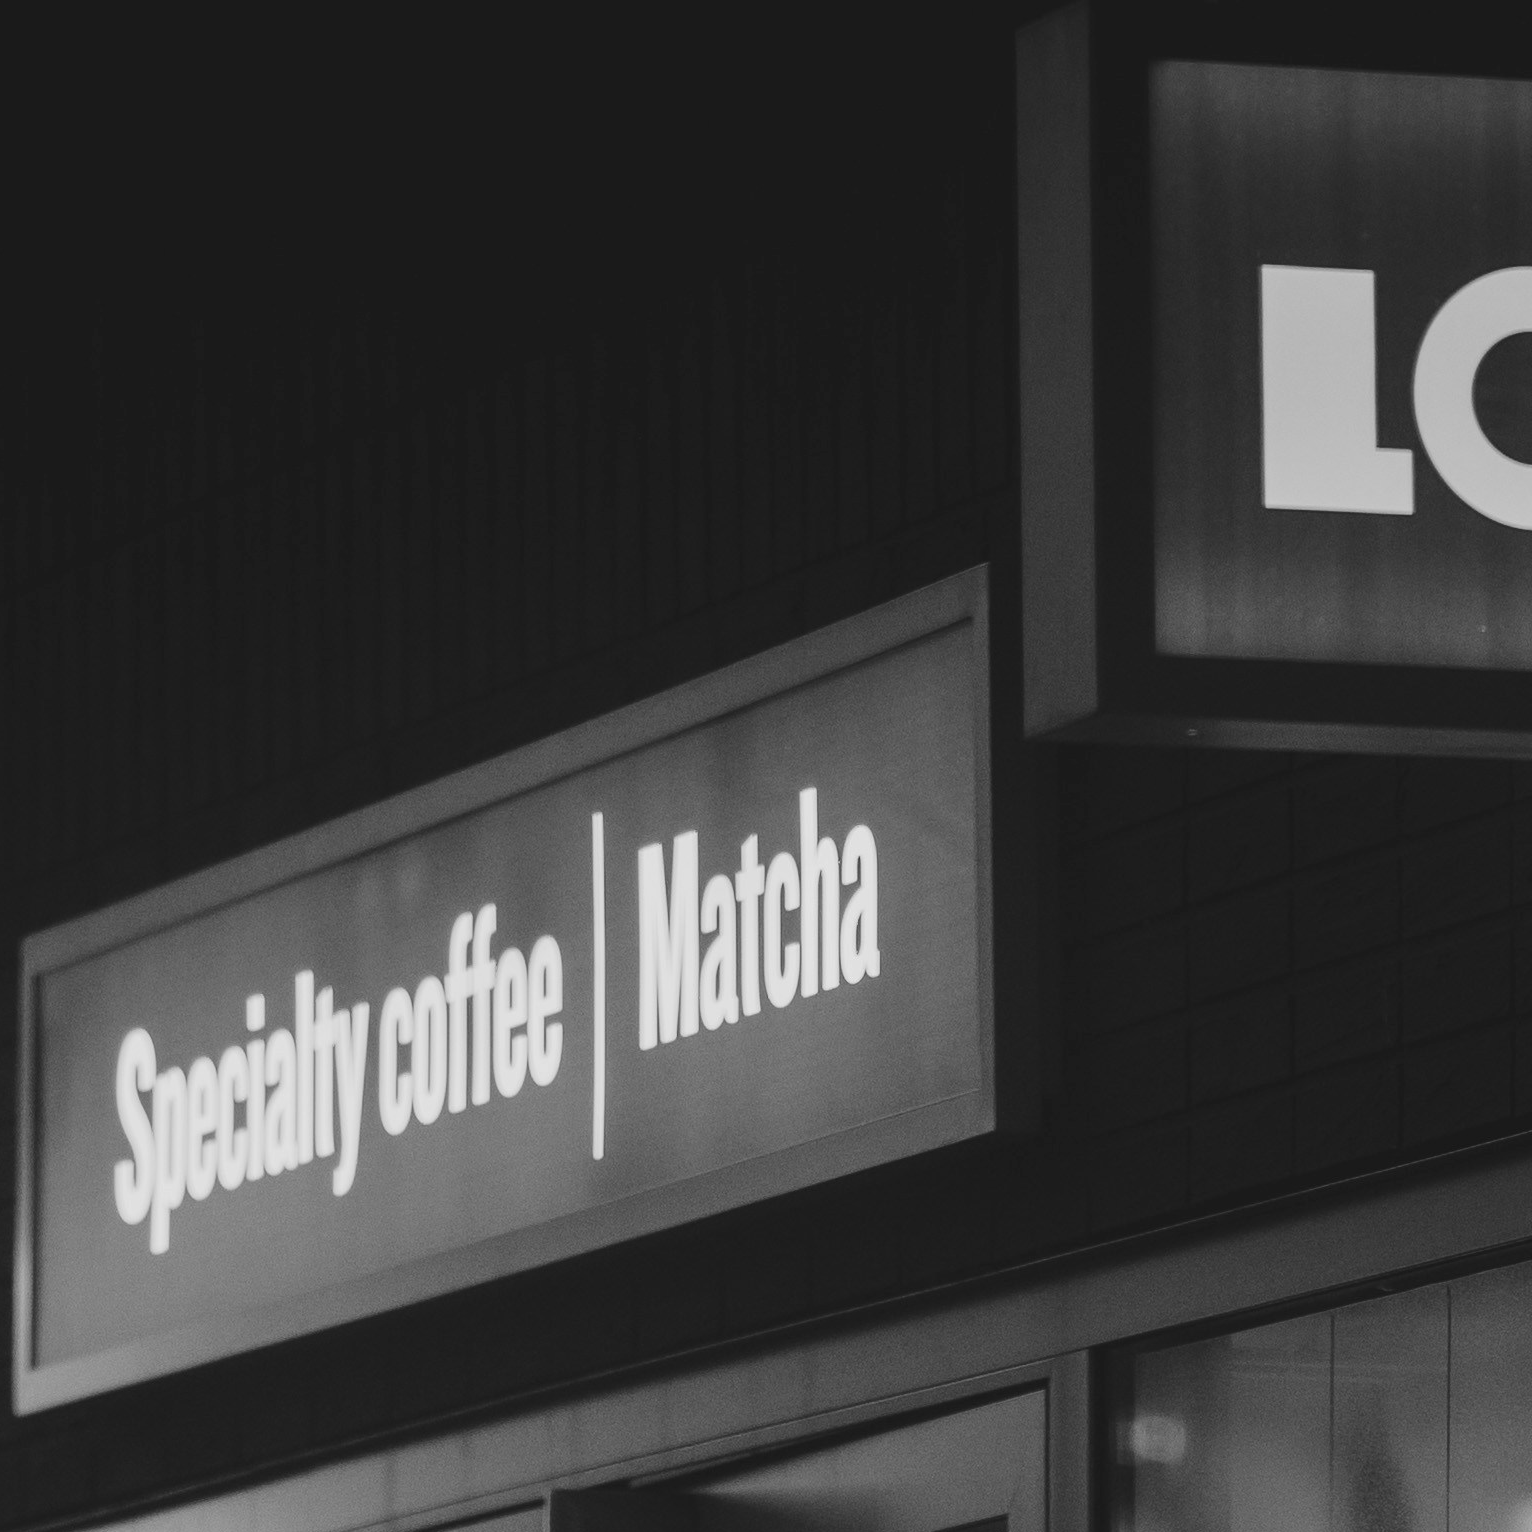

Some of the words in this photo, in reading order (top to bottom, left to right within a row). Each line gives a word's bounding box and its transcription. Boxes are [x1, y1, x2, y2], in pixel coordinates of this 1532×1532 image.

[113, 968, 371, 1257] Specialty
[377, 902, 565, 1137] coffee
[637, 786, 882, 1052] Matcha
